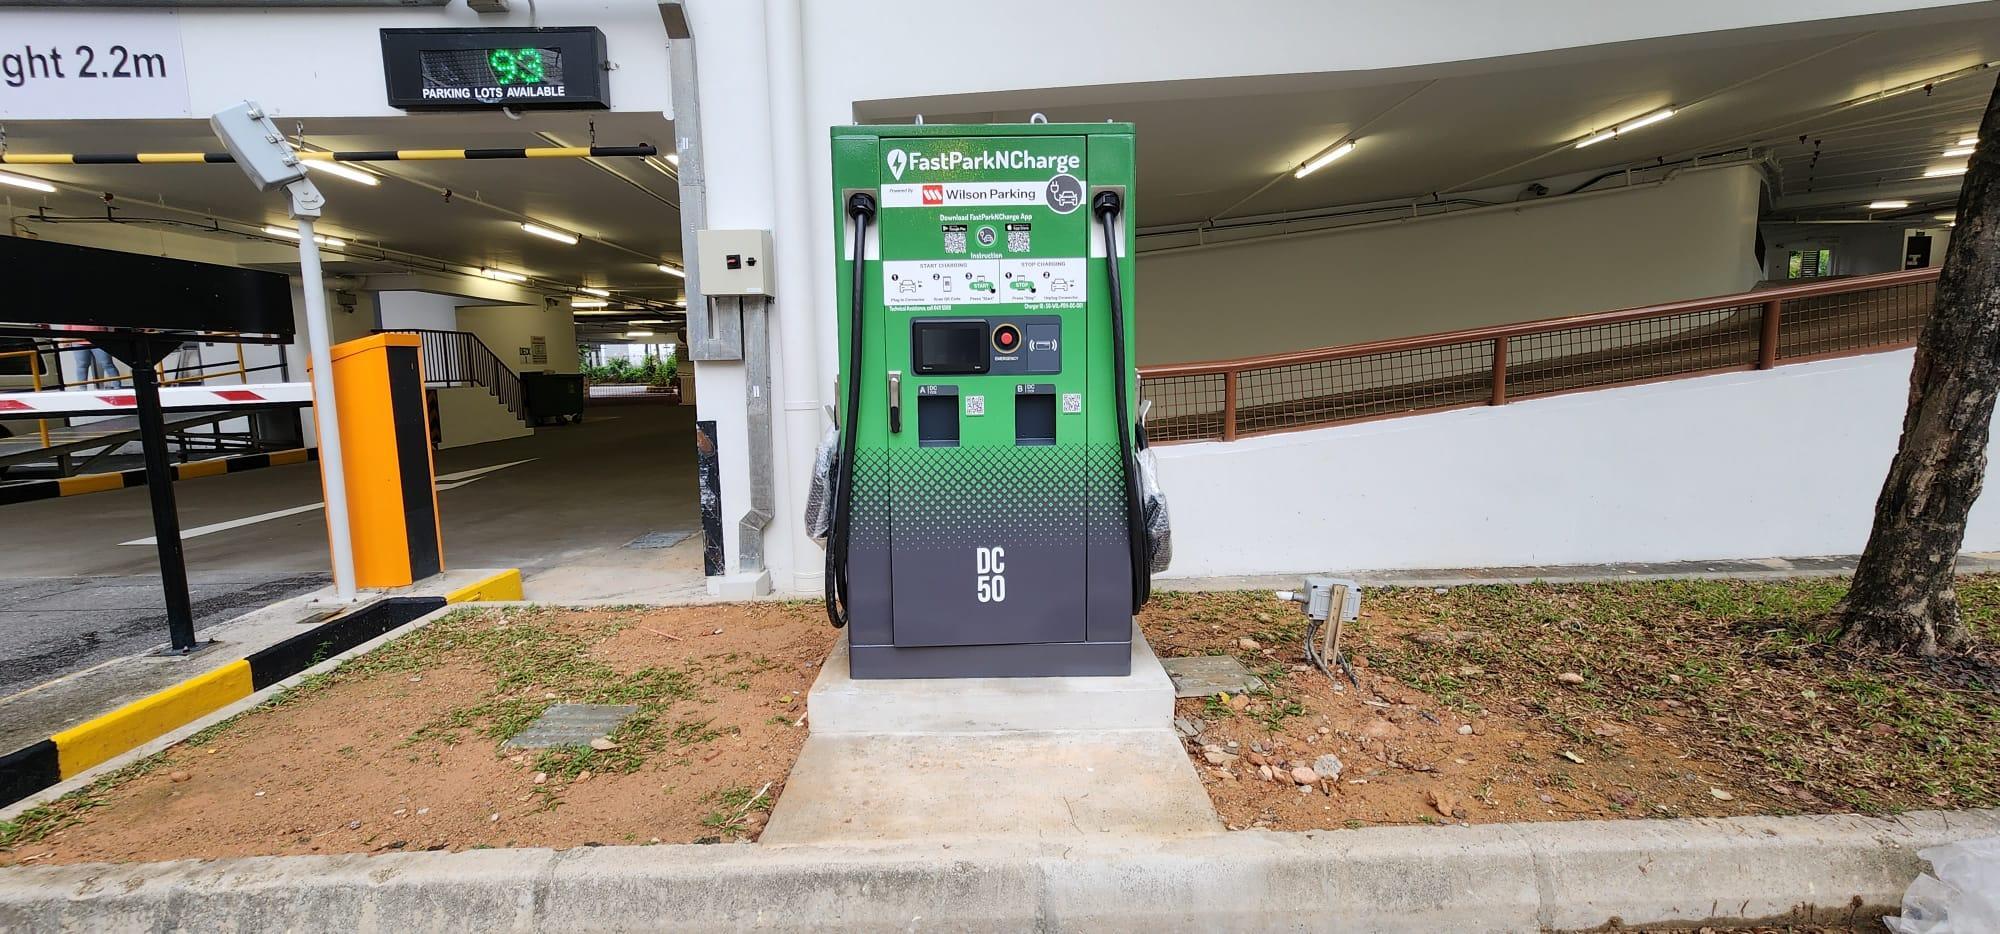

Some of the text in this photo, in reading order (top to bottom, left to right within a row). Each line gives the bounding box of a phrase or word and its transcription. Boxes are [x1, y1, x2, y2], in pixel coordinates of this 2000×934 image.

[75, 45, 167, 78] 2.2m
[422, 86, 566, 99] PARKING LOTS AVAILABLE
[909, 150, 1080, 173] FastParkNCharge
[946, 188, 1036, 200] Wilson Parking
[940, 213, 1033, 222] Download FastParkNCharge App
[971, 252, 1003, 260] Instruction
[919, 386, 927, 394] A
[1017, 384, 1023, 393] B
[976, 546, 1005, 575] DC
[977, 575, 1006, 603] 50
